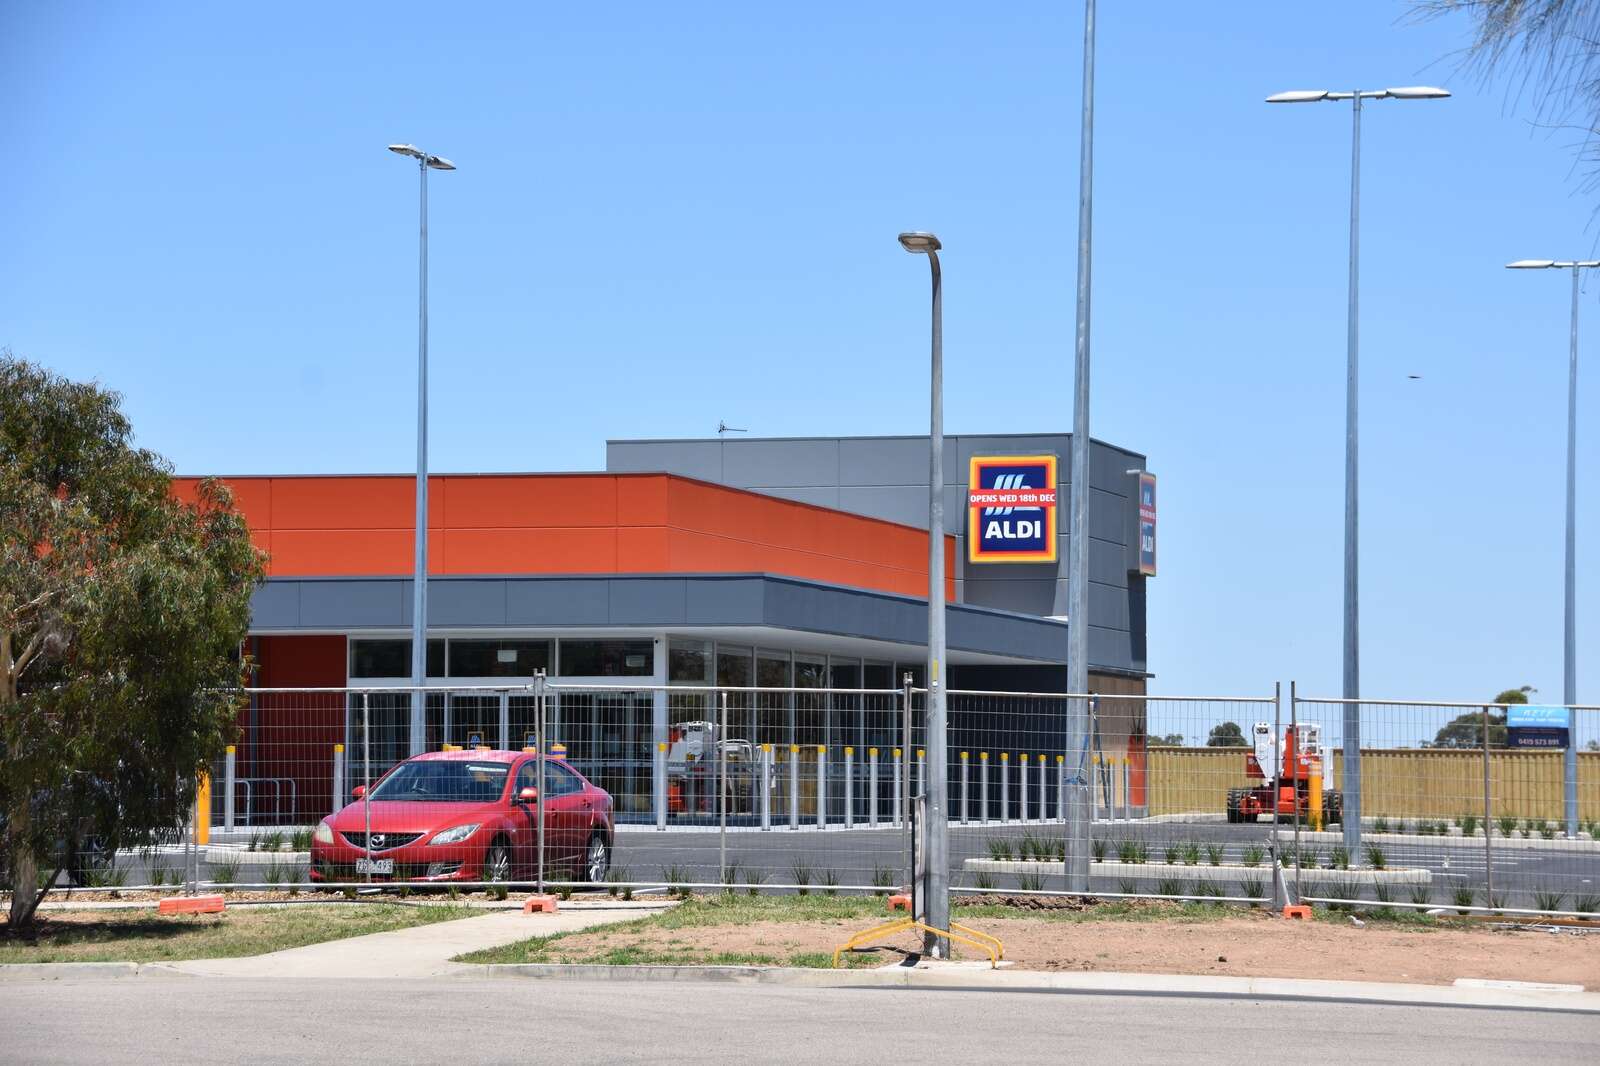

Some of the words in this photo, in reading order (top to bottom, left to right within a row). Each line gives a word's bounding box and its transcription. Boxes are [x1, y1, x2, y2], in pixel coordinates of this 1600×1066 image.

[970, 494, 997, 503] OPENS
[998, 494, 1018, 503] WED
[1019, 494, 1038, 503] 18th
[1039, 494, 1056, 502] DEC
[984, 520, 1041, 539] ALDI
